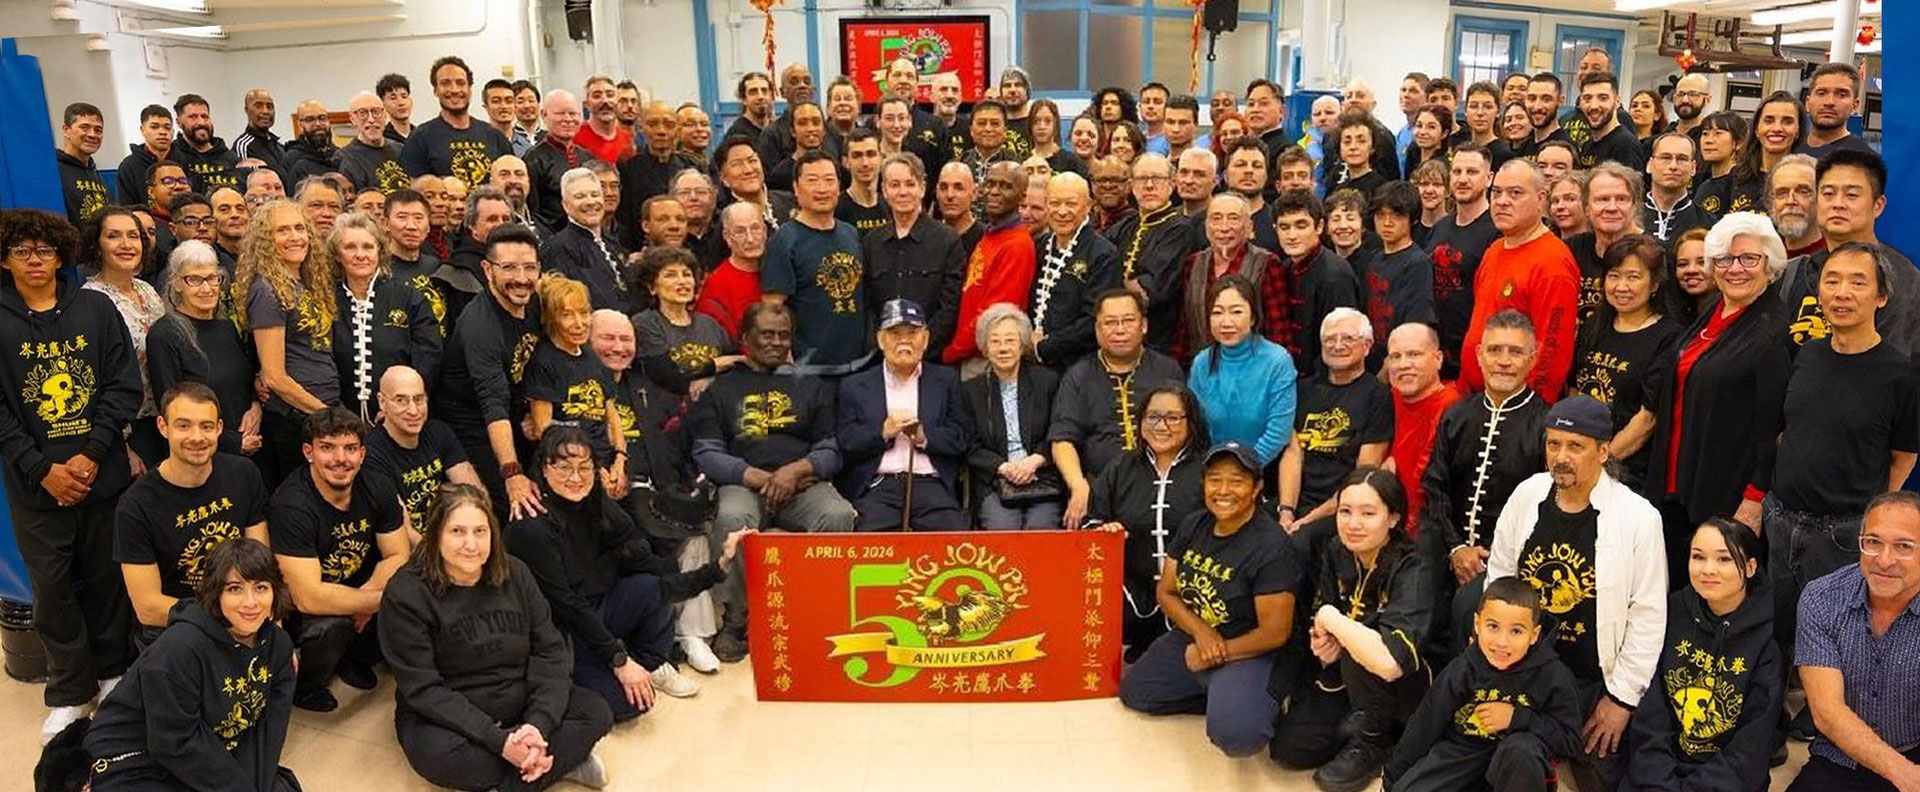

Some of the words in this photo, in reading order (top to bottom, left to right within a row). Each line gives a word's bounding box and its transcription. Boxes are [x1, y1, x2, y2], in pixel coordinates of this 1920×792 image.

[804, 546, 843, 559] APRIL
[862, 545, 895, 558] 2024
[1548, 543, 1586, 570] JOW
[895, 554, 939, 611] YING
[944, 542, 1006, 574] JOW
[912, 648, 1015, 664] ANNIVERSARY
[929, 671, 1037, 695] 岑亮鷹爪拳
